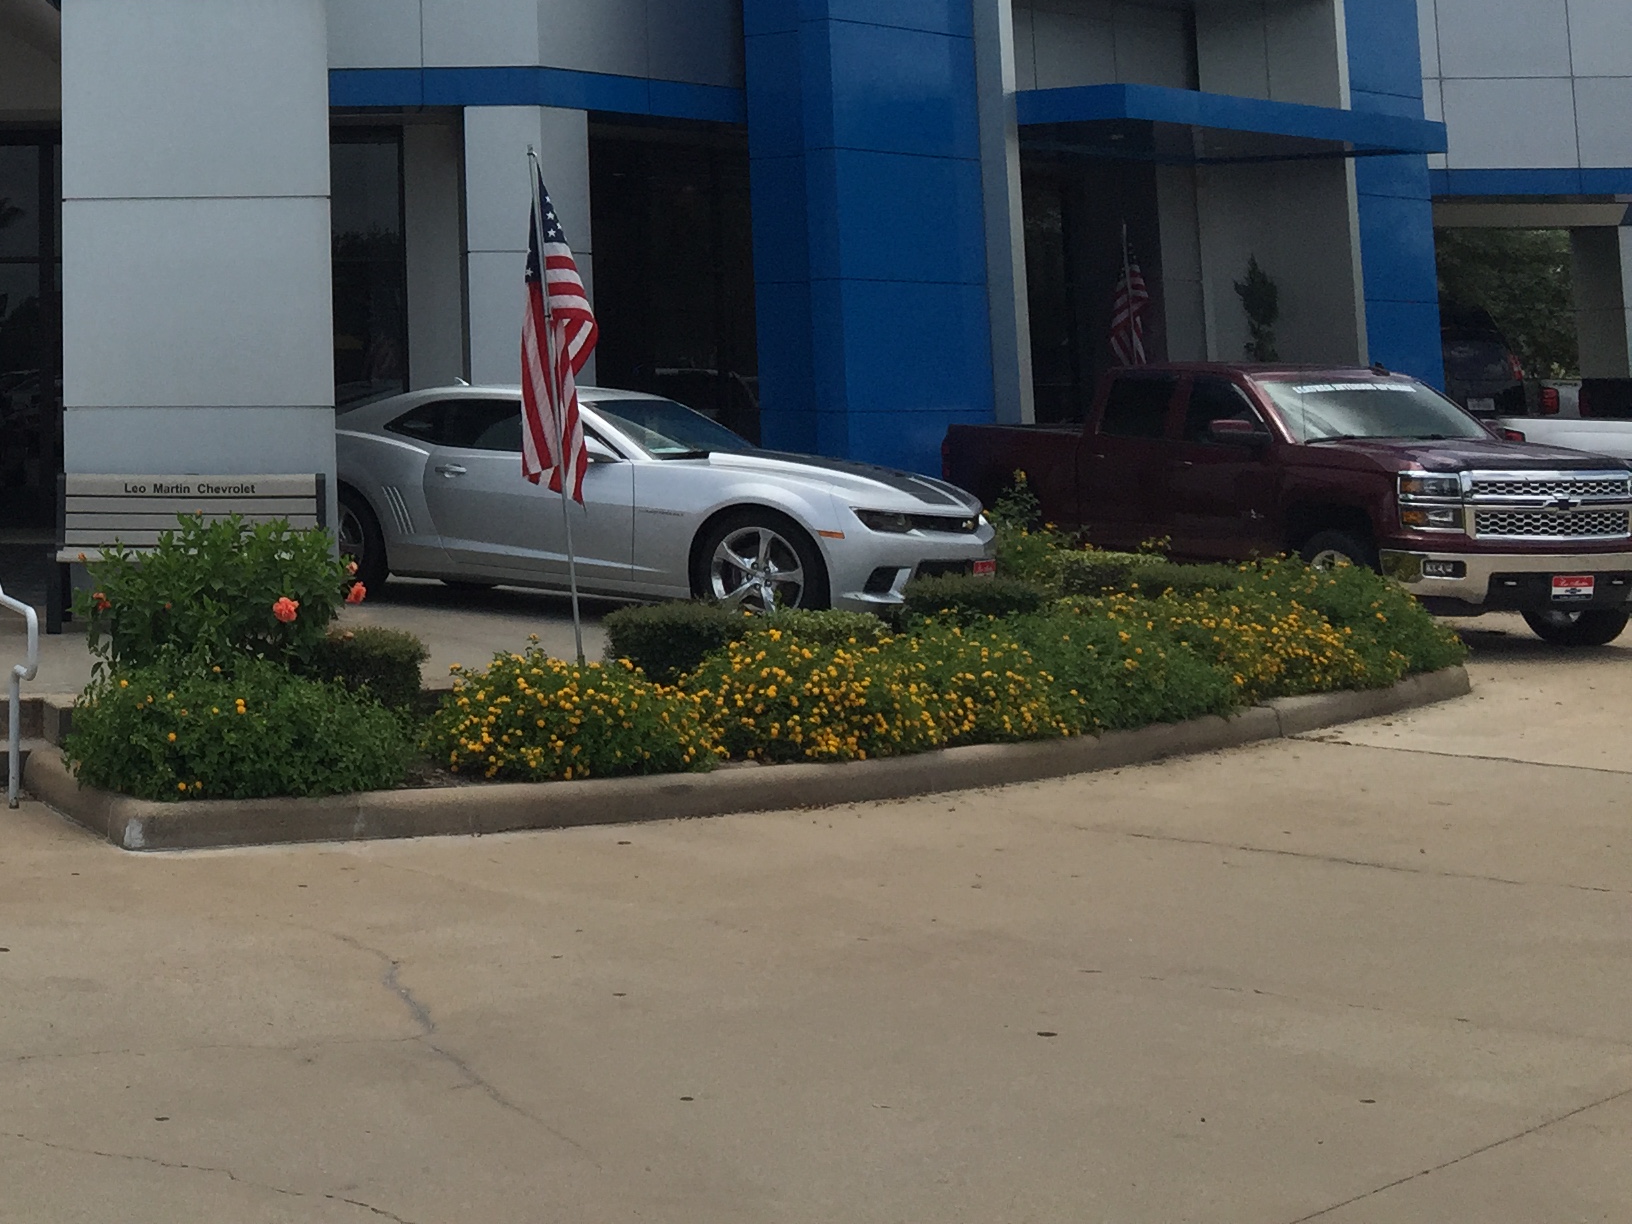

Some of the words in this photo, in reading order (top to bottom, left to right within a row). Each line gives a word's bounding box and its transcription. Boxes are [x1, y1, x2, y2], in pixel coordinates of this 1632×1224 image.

[124, 483, 146, 494] Leo
[153, 483, 190, 494] Martin
[197, 483, 255, 494] Chevrolet
